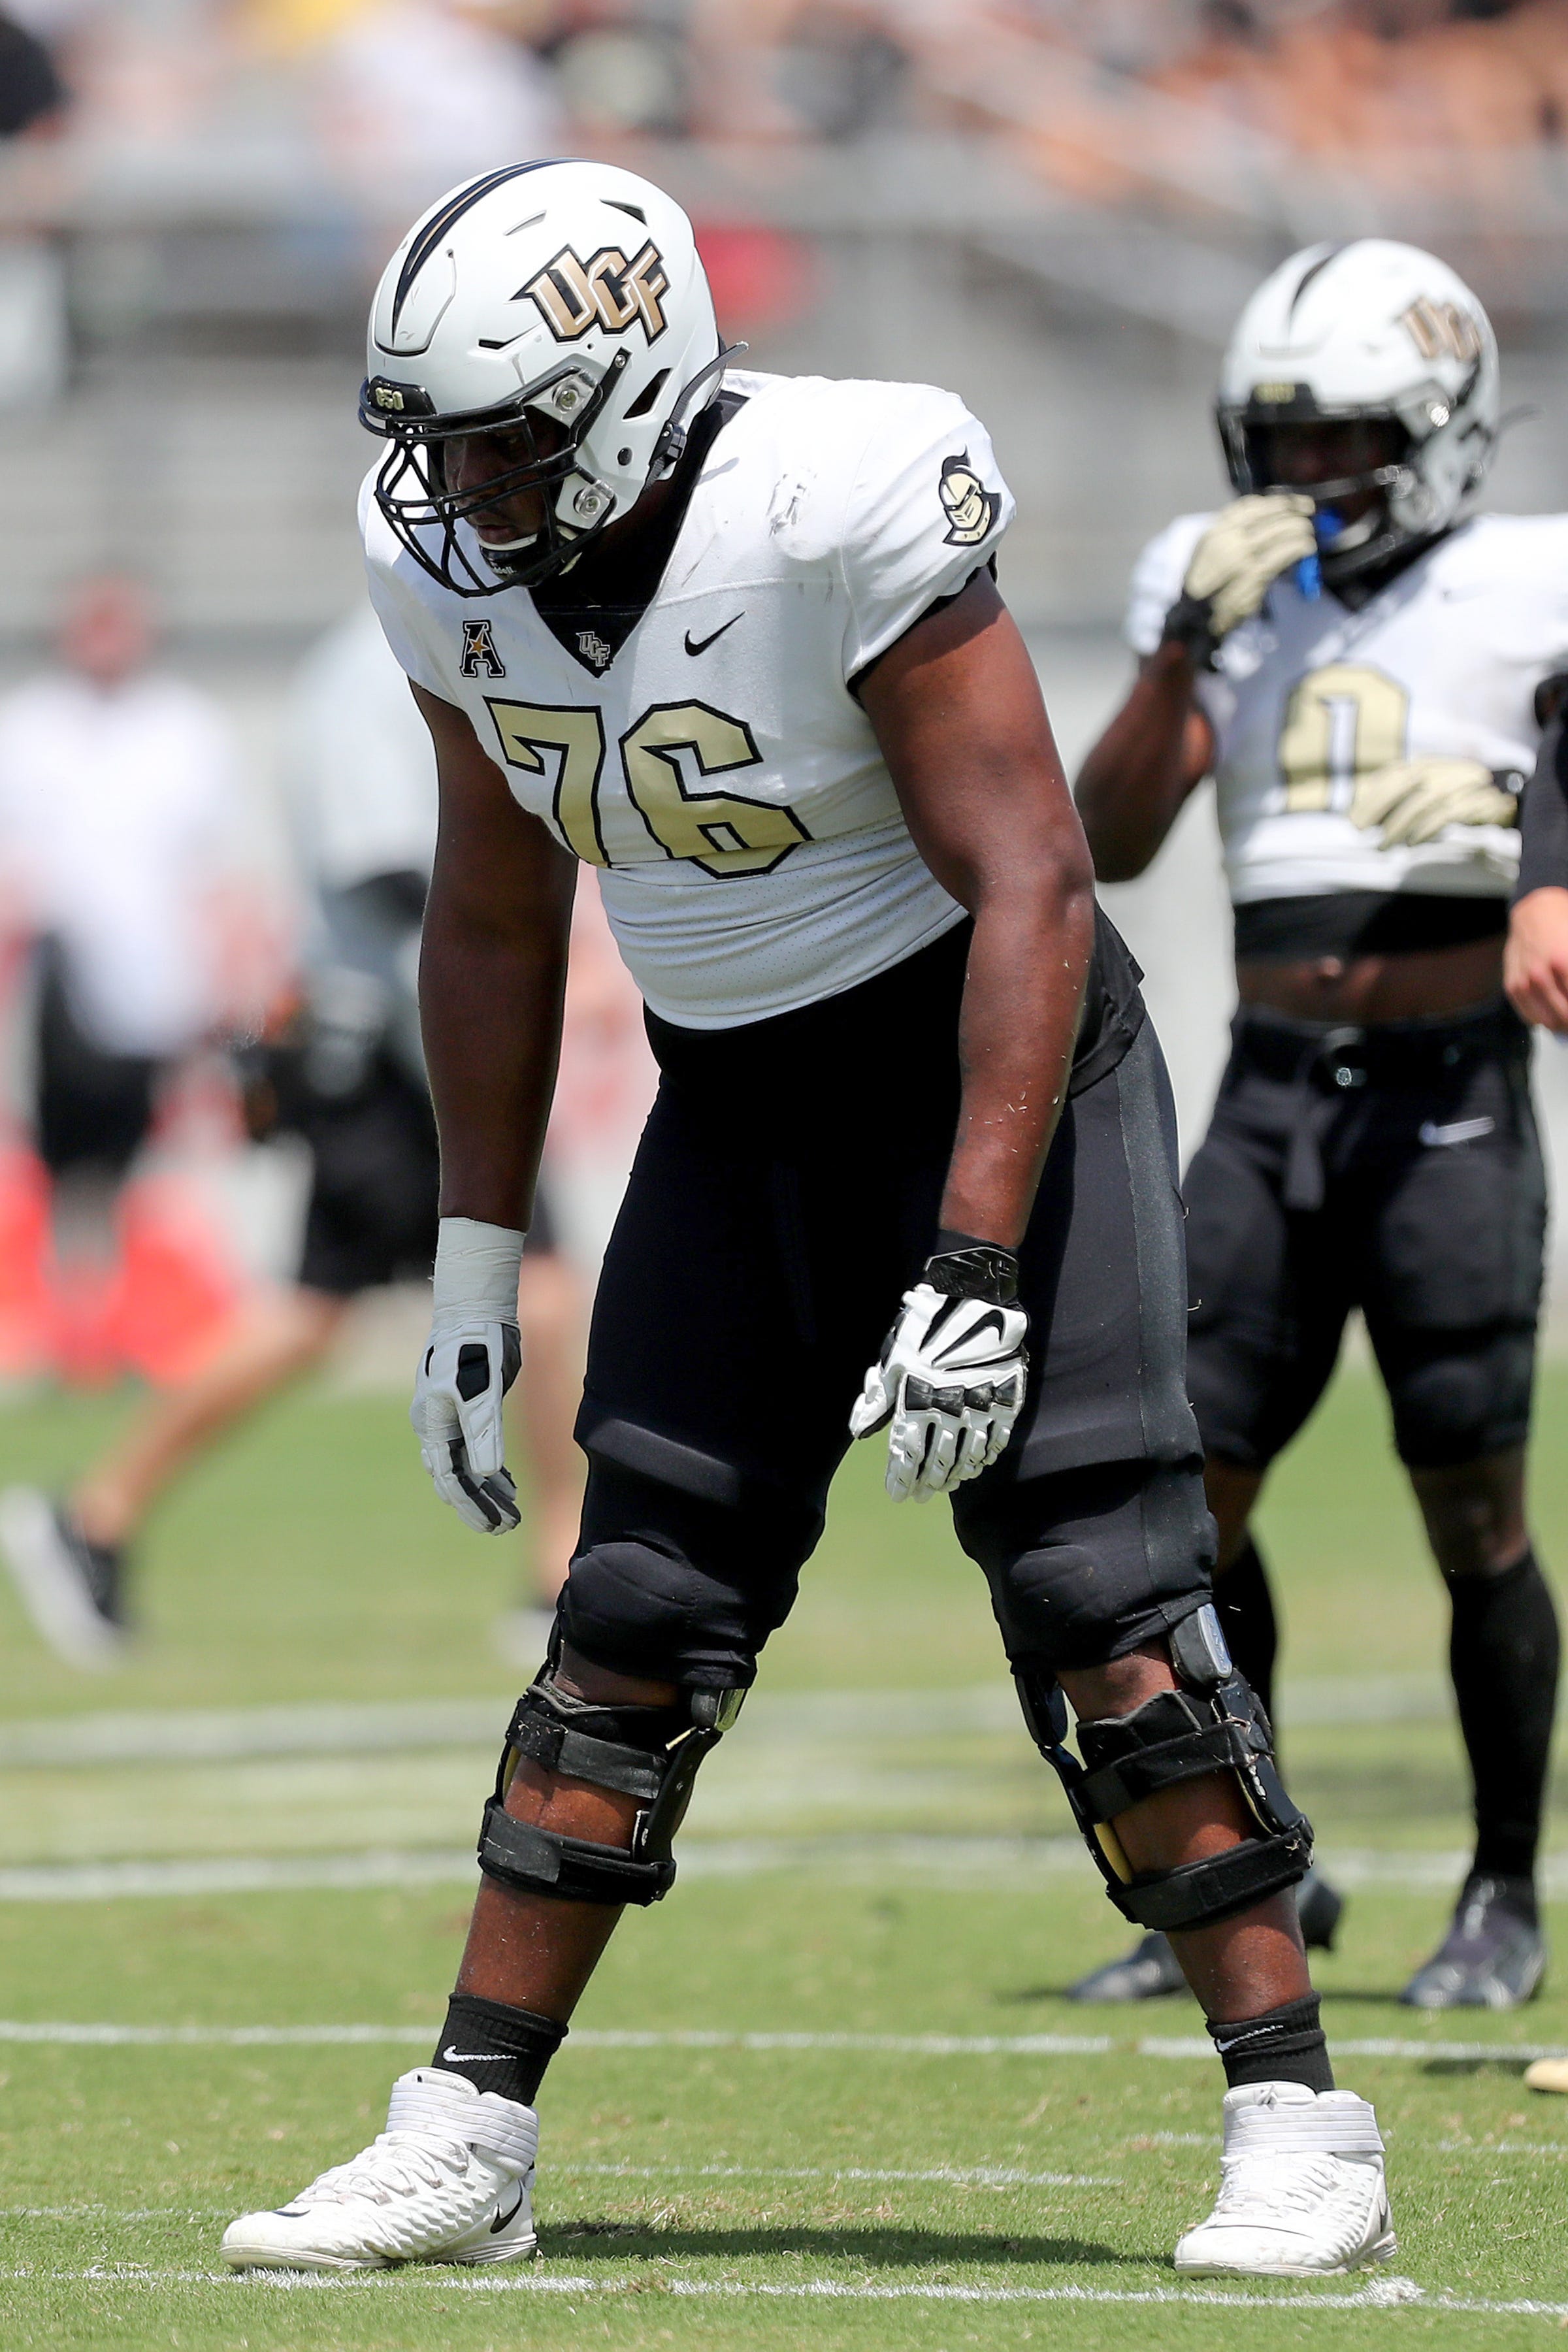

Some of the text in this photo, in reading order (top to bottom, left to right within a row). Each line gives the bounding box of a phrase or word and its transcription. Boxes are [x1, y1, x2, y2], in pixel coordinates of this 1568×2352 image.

[510, 238, 671, 348] UCF
[460, 619, 504, 678] A
[576, 631, 610, 666] UCF
[483, 696, 815, 879] 76
[1281, 664, 1407, 812] 0
